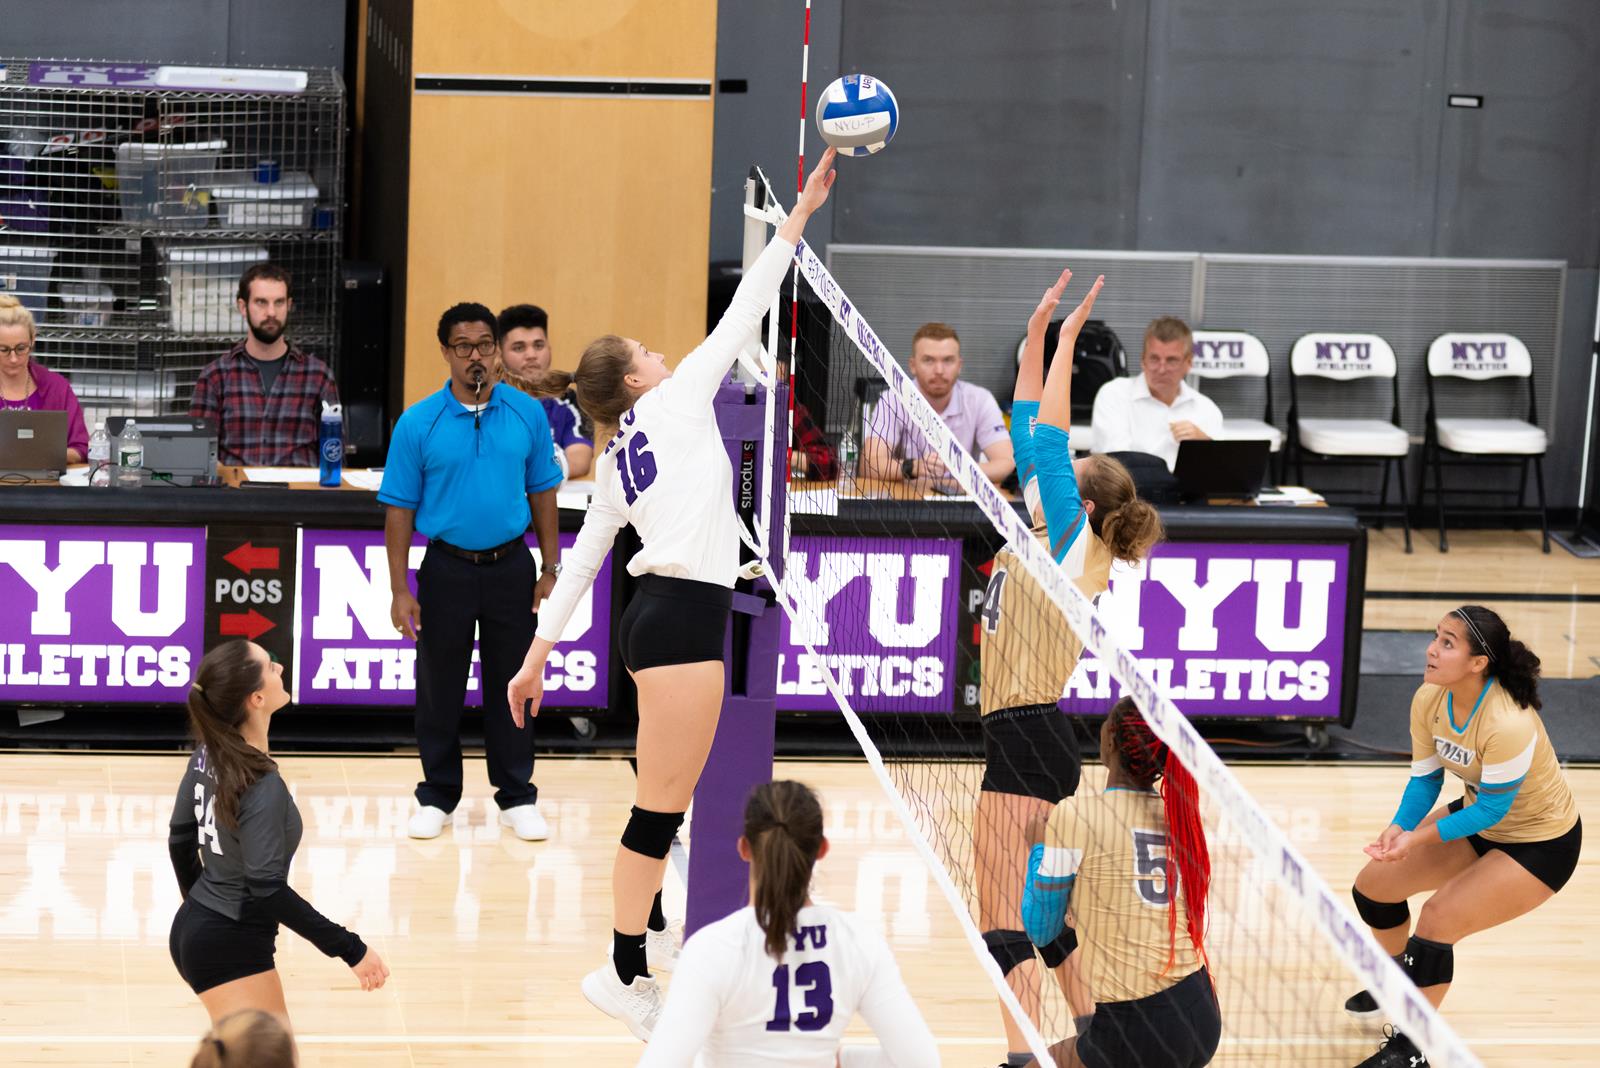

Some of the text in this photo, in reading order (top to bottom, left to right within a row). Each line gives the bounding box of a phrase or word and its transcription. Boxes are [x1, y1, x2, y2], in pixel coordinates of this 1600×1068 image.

[1315, 342, 1371, 360] NYU
[1451, 342, 1506, 360] NYU
[616, 431, 658, 507] 16
[215, 579, 283, 604] POSS
[981, 567, 1007, 634] 4
[0, 643, 191, 687] LETICS
[194, 782, 224, 856] 24
[1131, 828, 1181, 908] 5
[789, 924, 827, 951] YU
[766, 960, 834, 1032] 13
